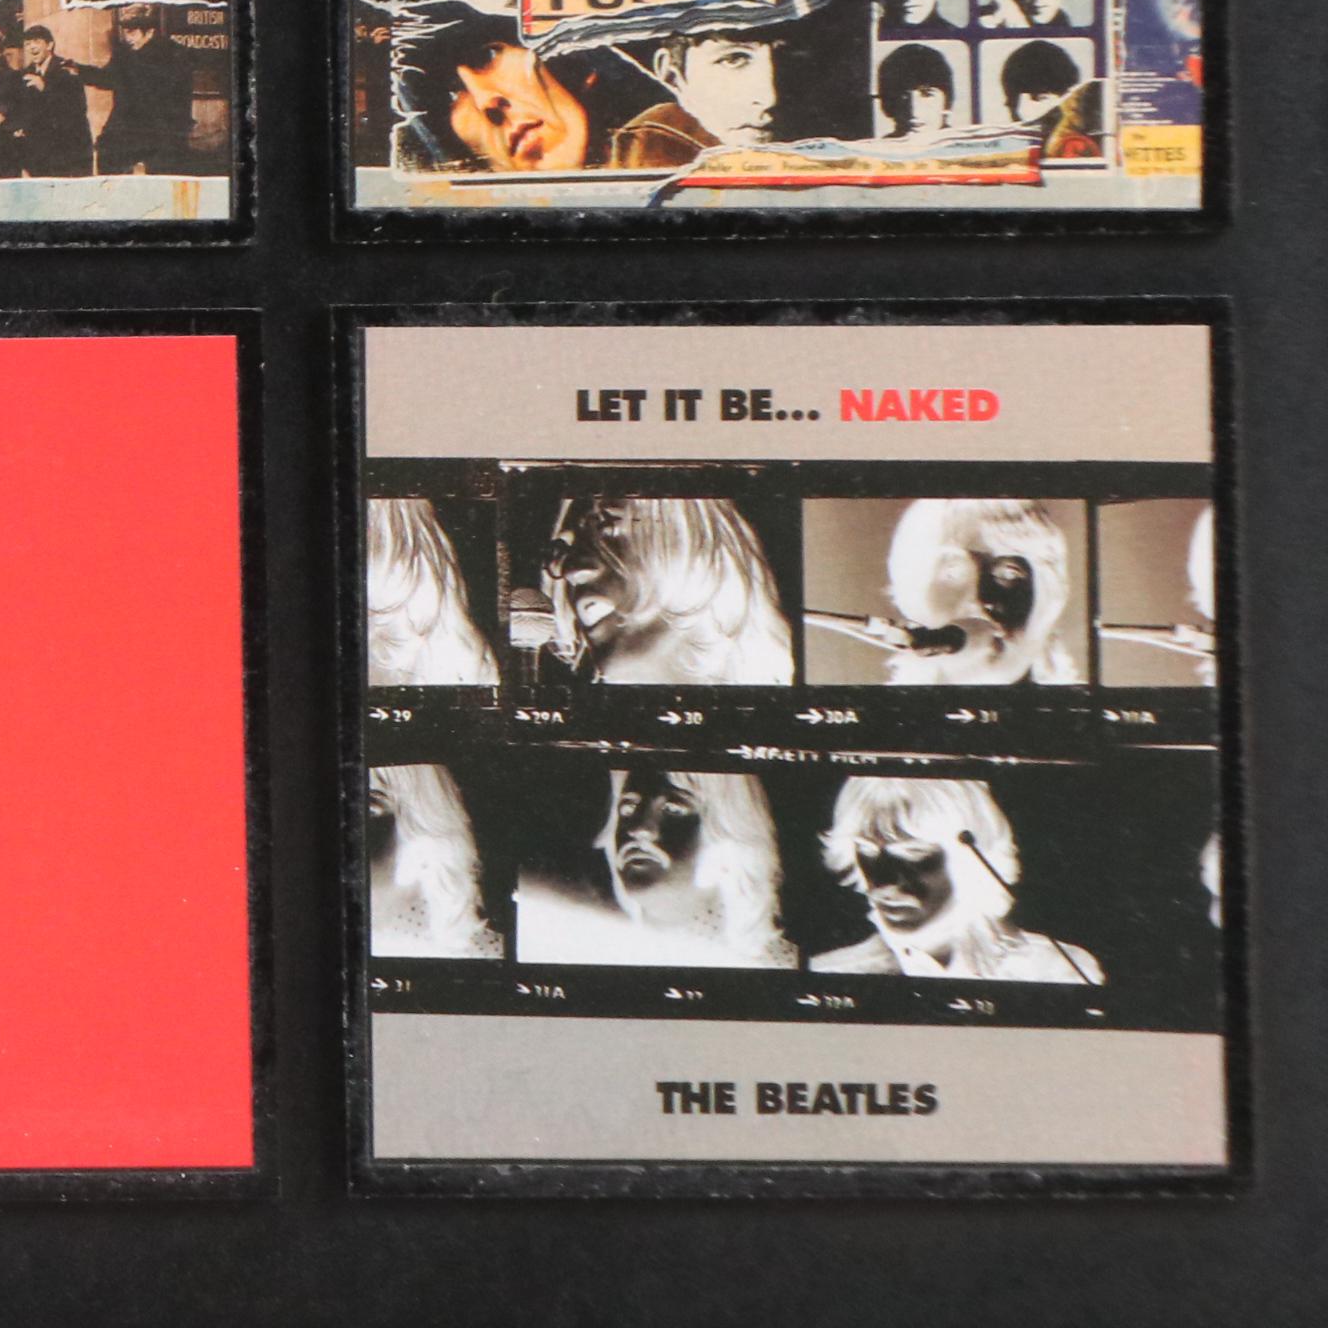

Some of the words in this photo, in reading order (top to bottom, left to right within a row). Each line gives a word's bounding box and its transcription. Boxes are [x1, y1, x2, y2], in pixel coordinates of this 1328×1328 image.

[576, 388, 647, 422] LET
[664, 388, 704, 422] IT
[840, 387, 1000, 422] NAKED
[655, 1080, 738, 1115] THE
[755, 1081, 939, 1117] BEATLES
